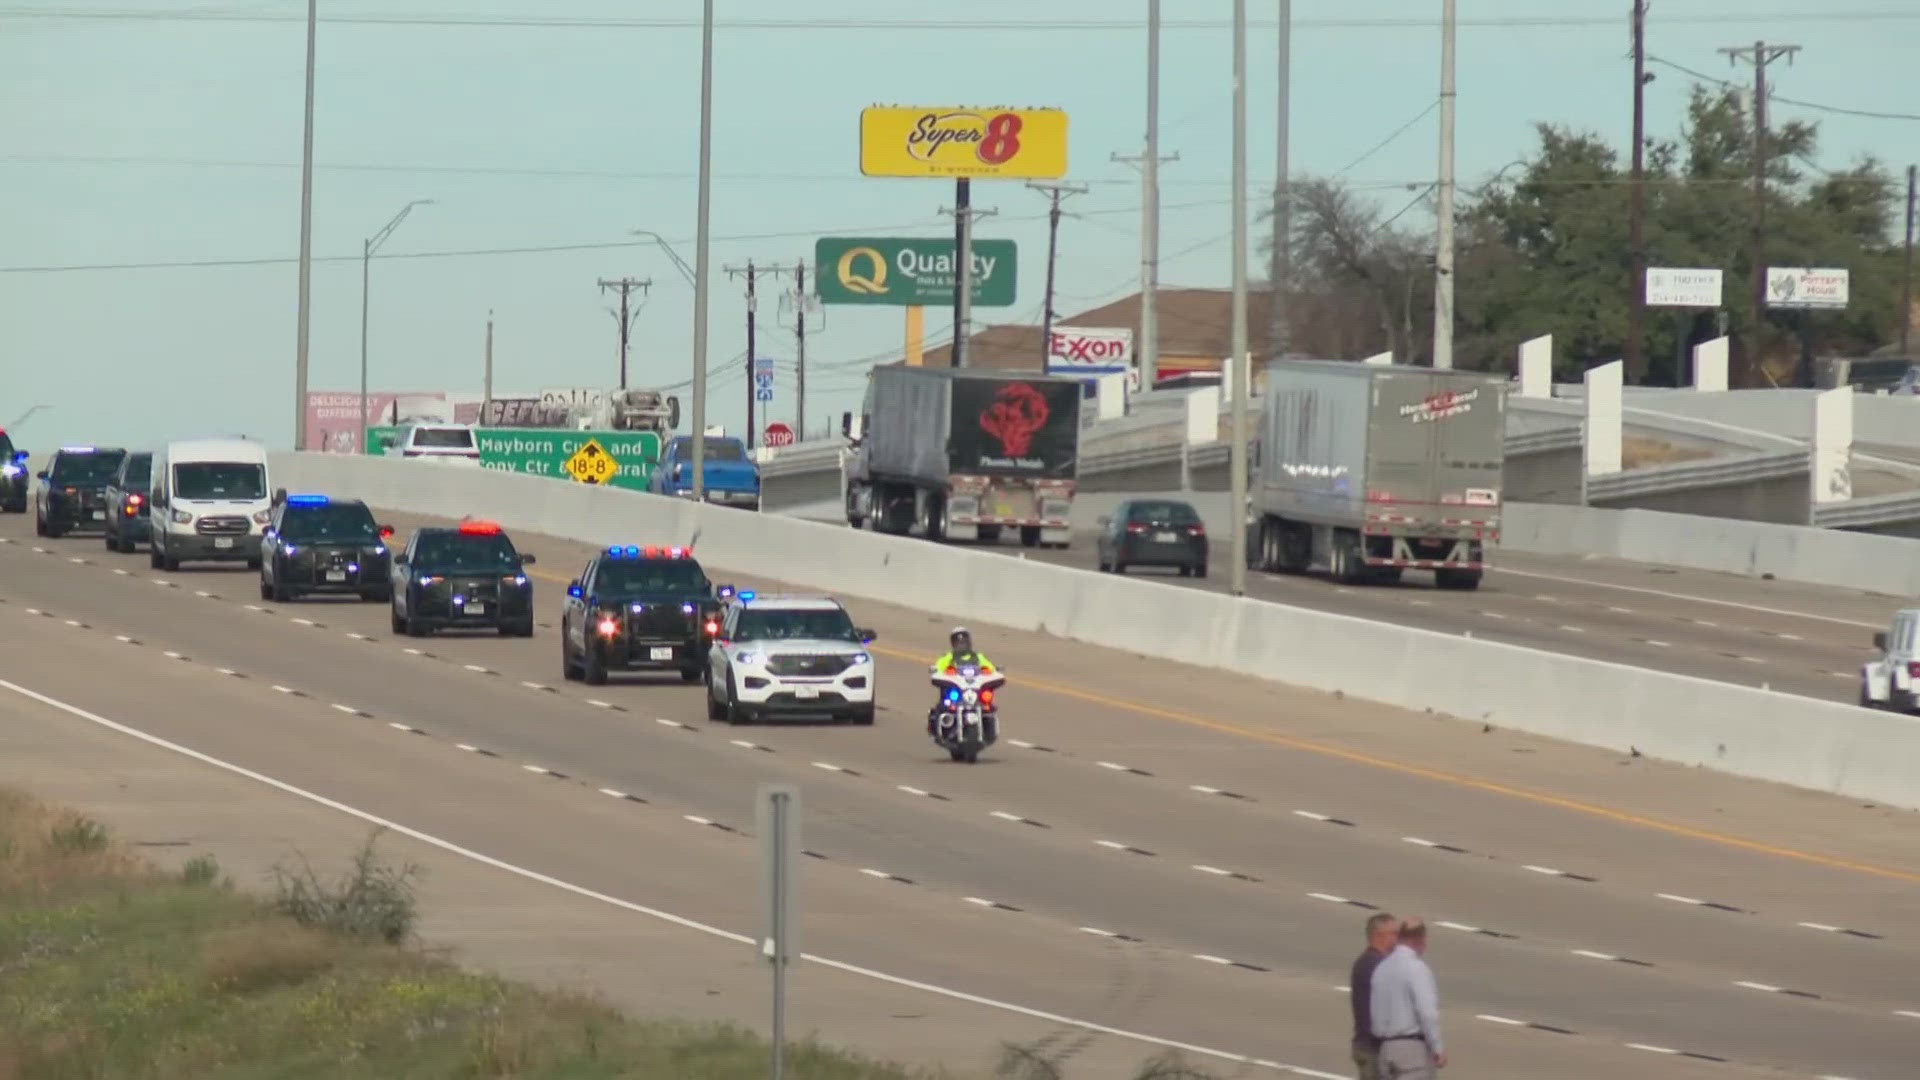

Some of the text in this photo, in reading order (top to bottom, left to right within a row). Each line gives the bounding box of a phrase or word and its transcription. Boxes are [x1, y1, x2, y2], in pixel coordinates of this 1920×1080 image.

[908, 113, 1023, 165] Super 8
[897, 248, 996, 279] Qualty
[1051, 333, 1124, 363] Exxon
[310, 395, 378, 406] DELICIOULY
[481, 437, 553, 456] Mayborn
[610, 440, 642, 455] and
[765, 432, 792, 444] STOP
[525, 460, 550, 473] Ctr
